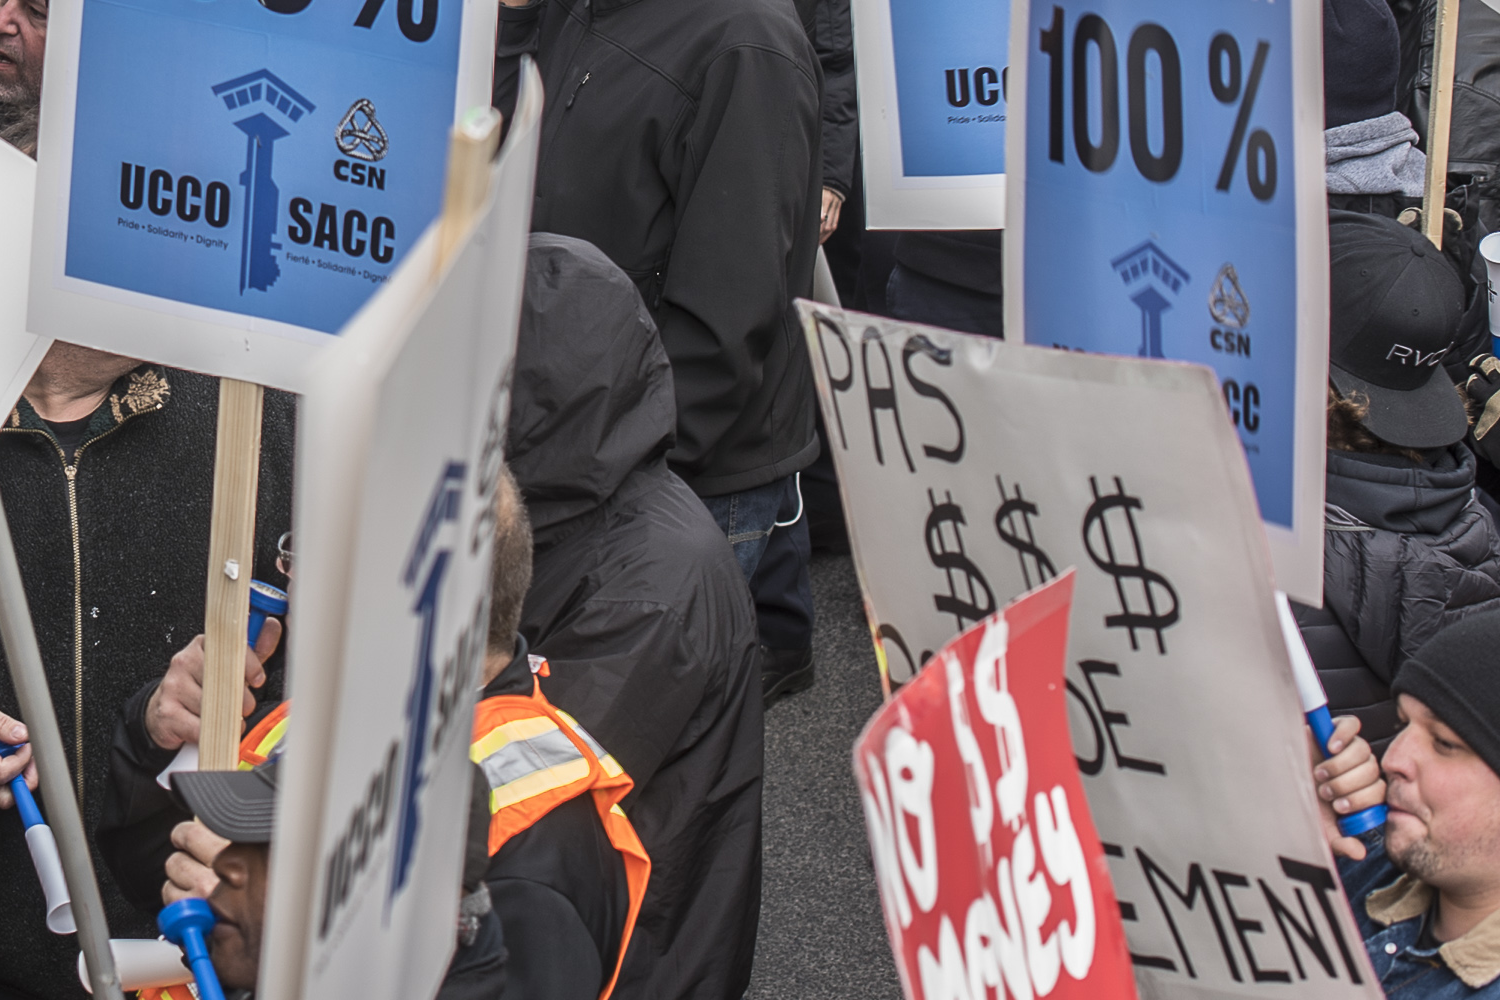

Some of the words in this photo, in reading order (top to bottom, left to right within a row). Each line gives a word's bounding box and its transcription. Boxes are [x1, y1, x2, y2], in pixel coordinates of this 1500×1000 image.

[1039, 5, 1183, 183] 100
[1208, 31, 1278, 203] %
[333, 159, 387, 190] CSN
[117, 217, 140, 231] Pride
[147, 223, 189, 242] Solidarity
[196, 234, 229, 251] Dignity
[120, 161, 231, 228] UCCO
[287, 197, 396, 265] SACC
[286, 252, 310, 266] Fierté
[317, 258, 357, 277] Solidarité
[1210, 328, 1251, 358] CSN
[811, 309, 966, 473] PAS
[1222, 377, 1260, 434] CC
